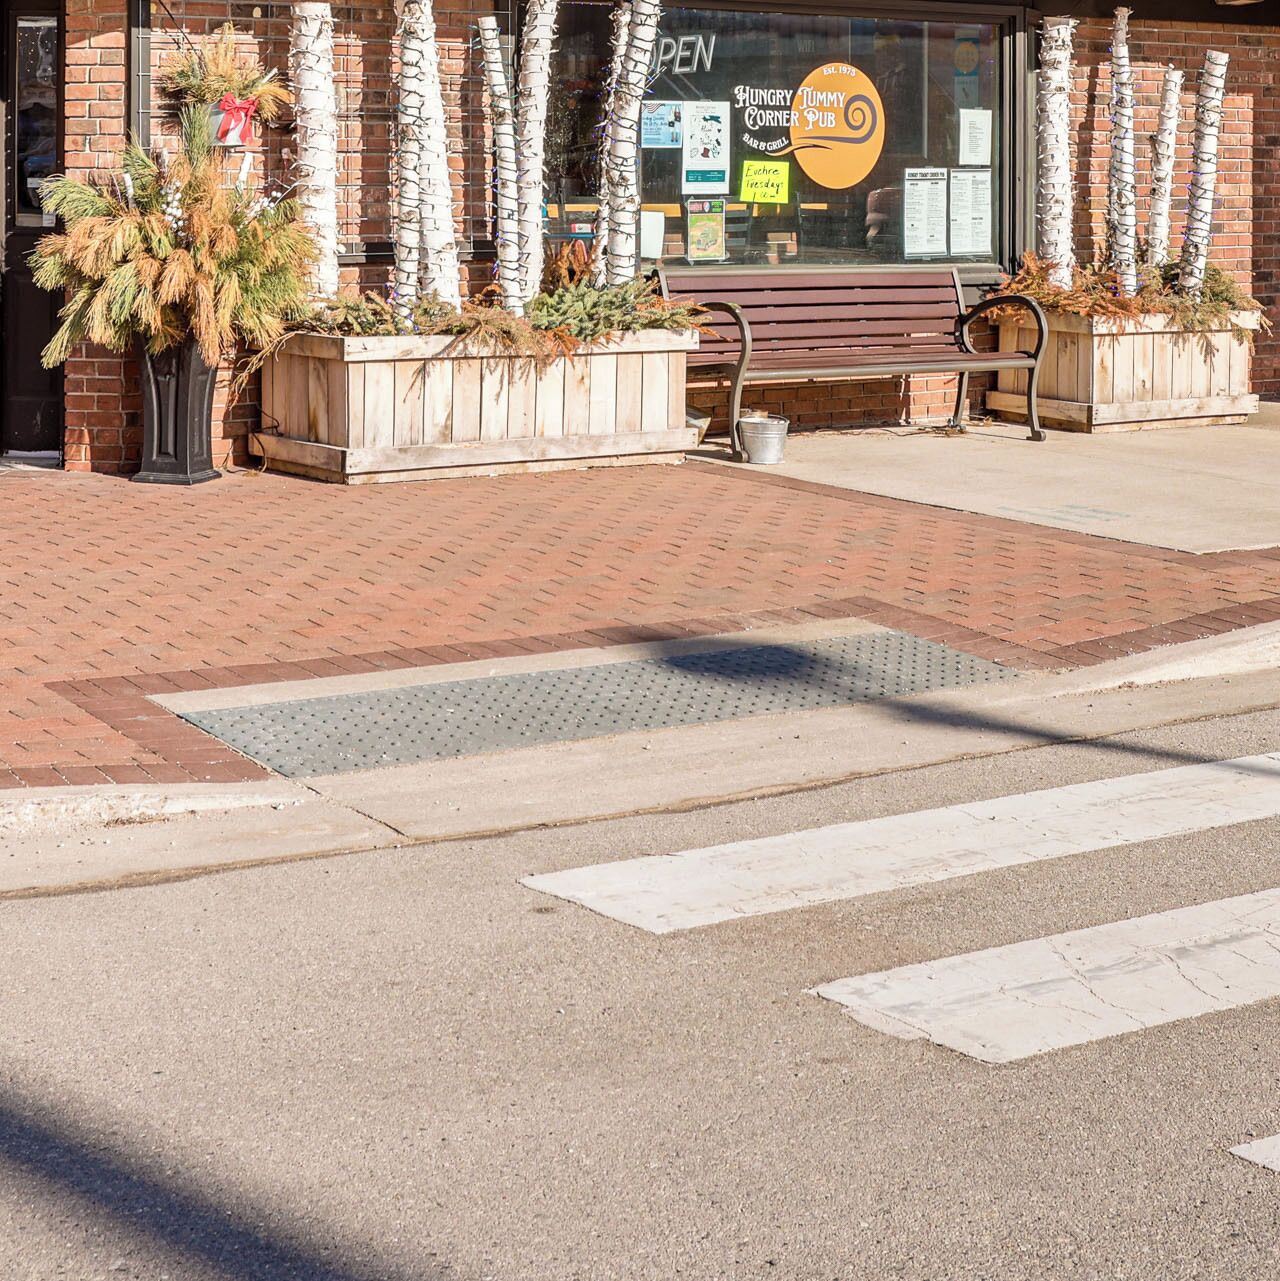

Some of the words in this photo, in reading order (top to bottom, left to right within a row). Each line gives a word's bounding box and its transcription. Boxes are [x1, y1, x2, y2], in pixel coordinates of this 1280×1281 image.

[651, 33, 716, 74] PEN
[734, 85, 794, 108] HUNGRY
[798, 86, 846, 110] TUMMY
[744, 106, 800, 130] CORNER
[804, 107, 836, 131] PUB
[742, 133, 759, 150] BAR
[766, 136, 790, 151] GRILL
